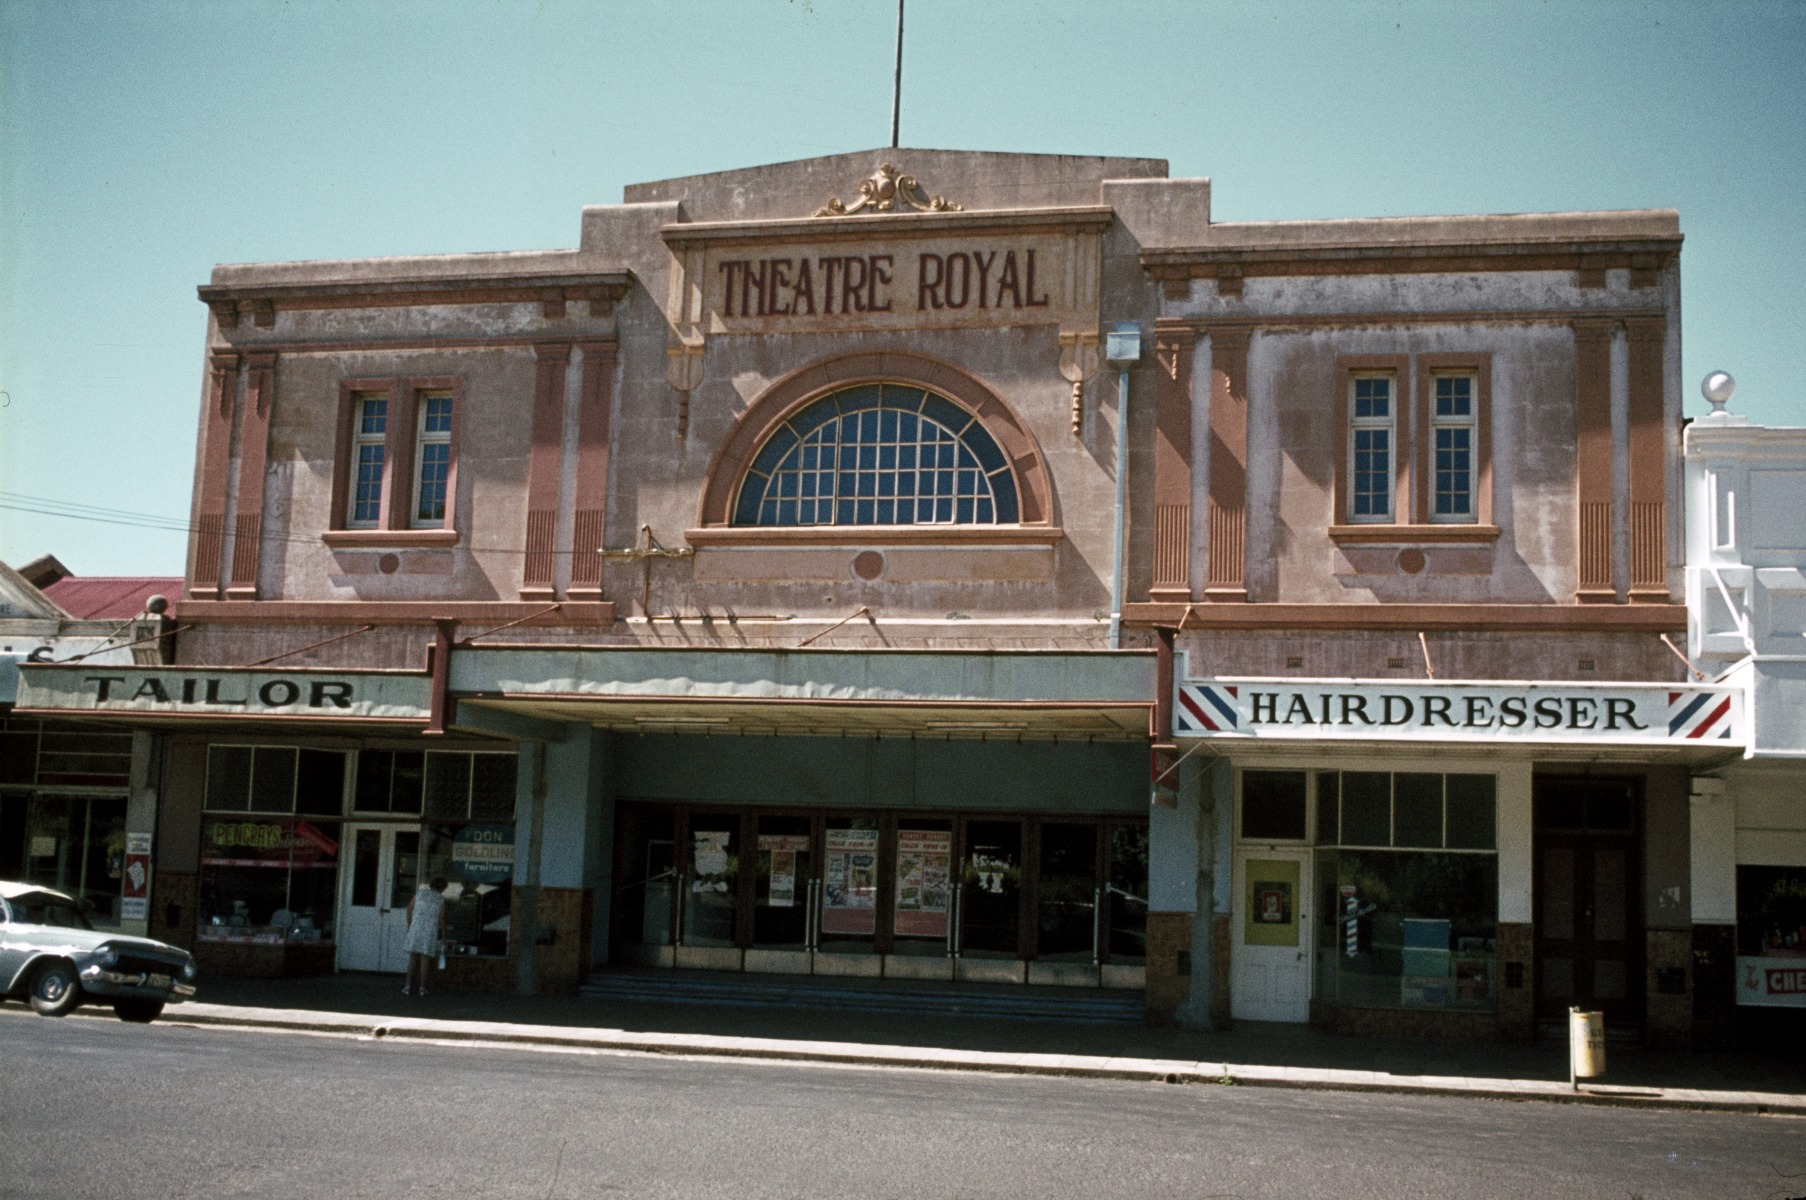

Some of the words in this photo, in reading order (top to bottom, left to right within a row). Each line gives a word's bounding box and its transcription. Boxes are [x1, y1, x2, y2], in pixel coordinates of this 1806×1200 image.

[719, 254, 894, 318] THEATRE
[917, 249, 1049, 311] ROYAL
[84, 676, 355, 709] TAILOR
[1249, 692, 1649, 731] HAIRDRESSER
[473, 831, 503, 842] DON
